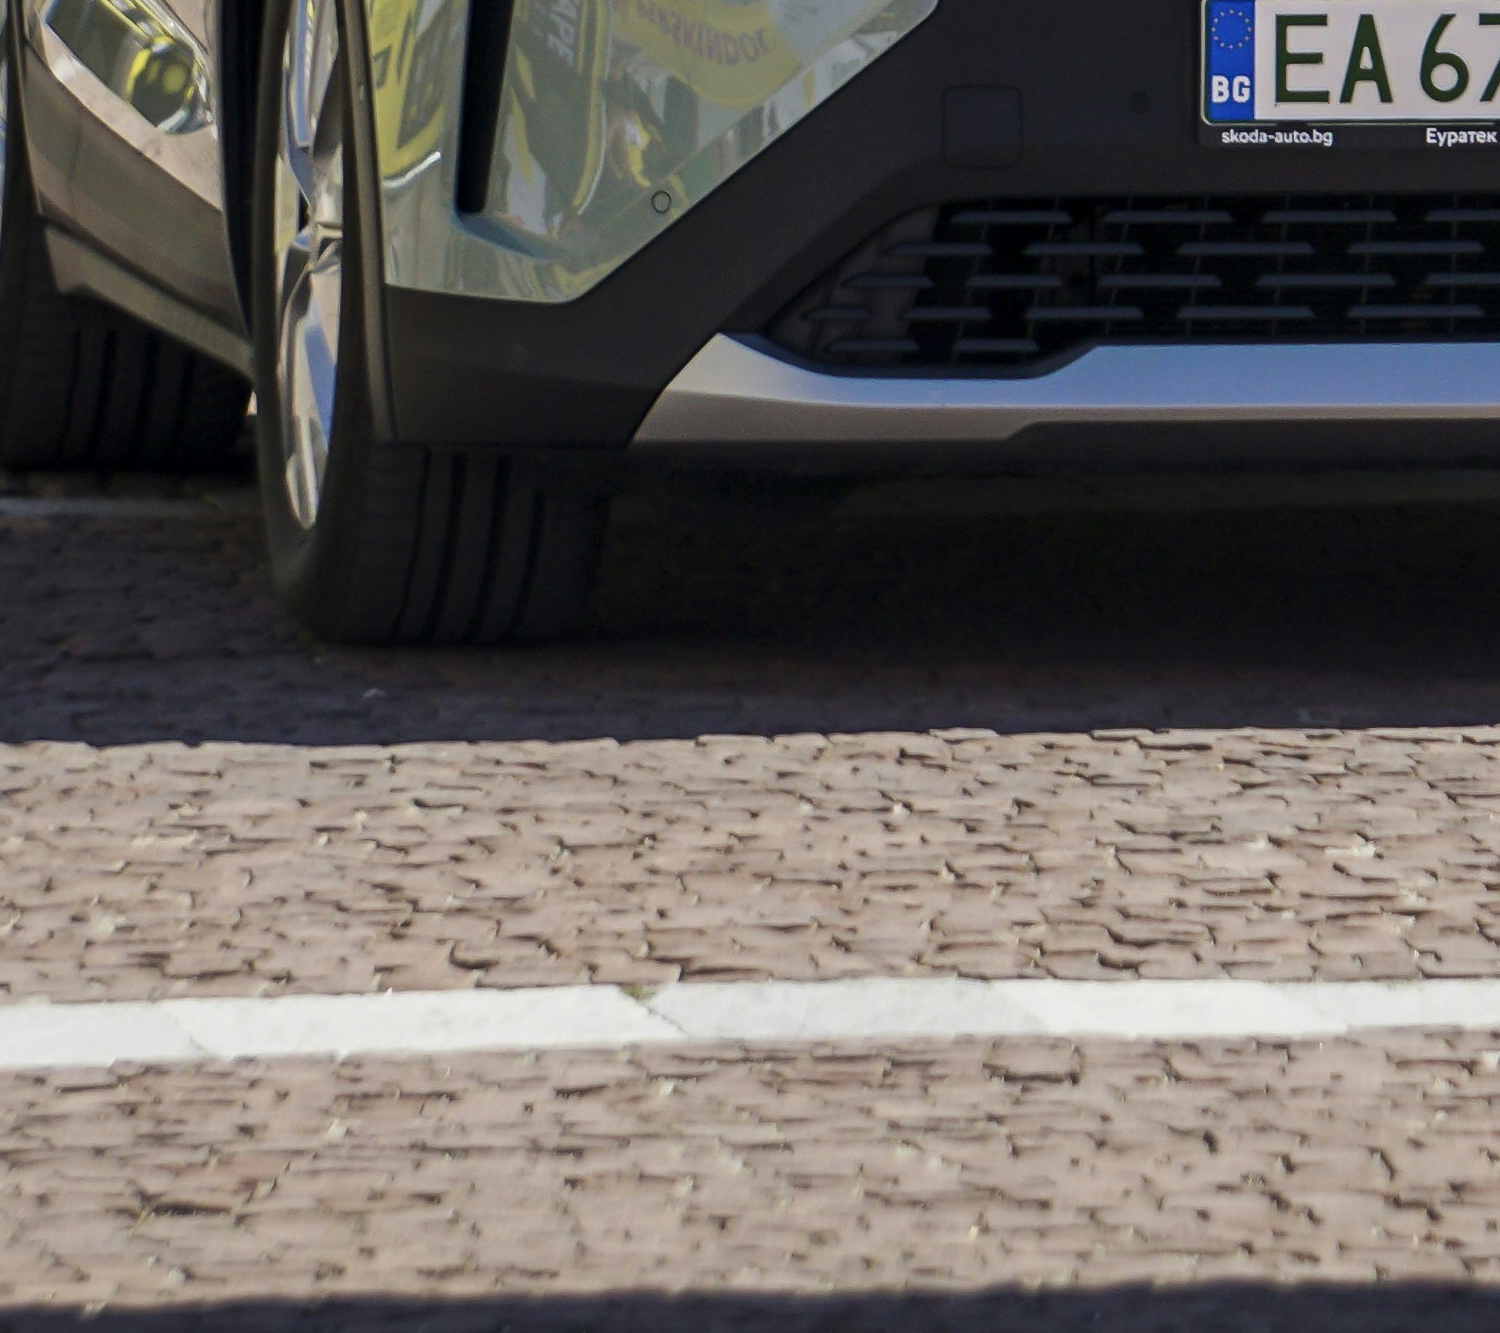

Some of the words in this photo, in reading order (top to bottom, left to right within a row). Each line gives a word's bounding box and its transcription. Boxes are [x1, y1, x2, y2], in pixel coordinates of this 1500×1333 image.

[1273, 13, 1394, 105] EA
[1211, 74, 1252, 105] BG
[1221, 128, 1335, 148] skoda-auto.bg
[1425, 128, 1499, 148] Еуратек
